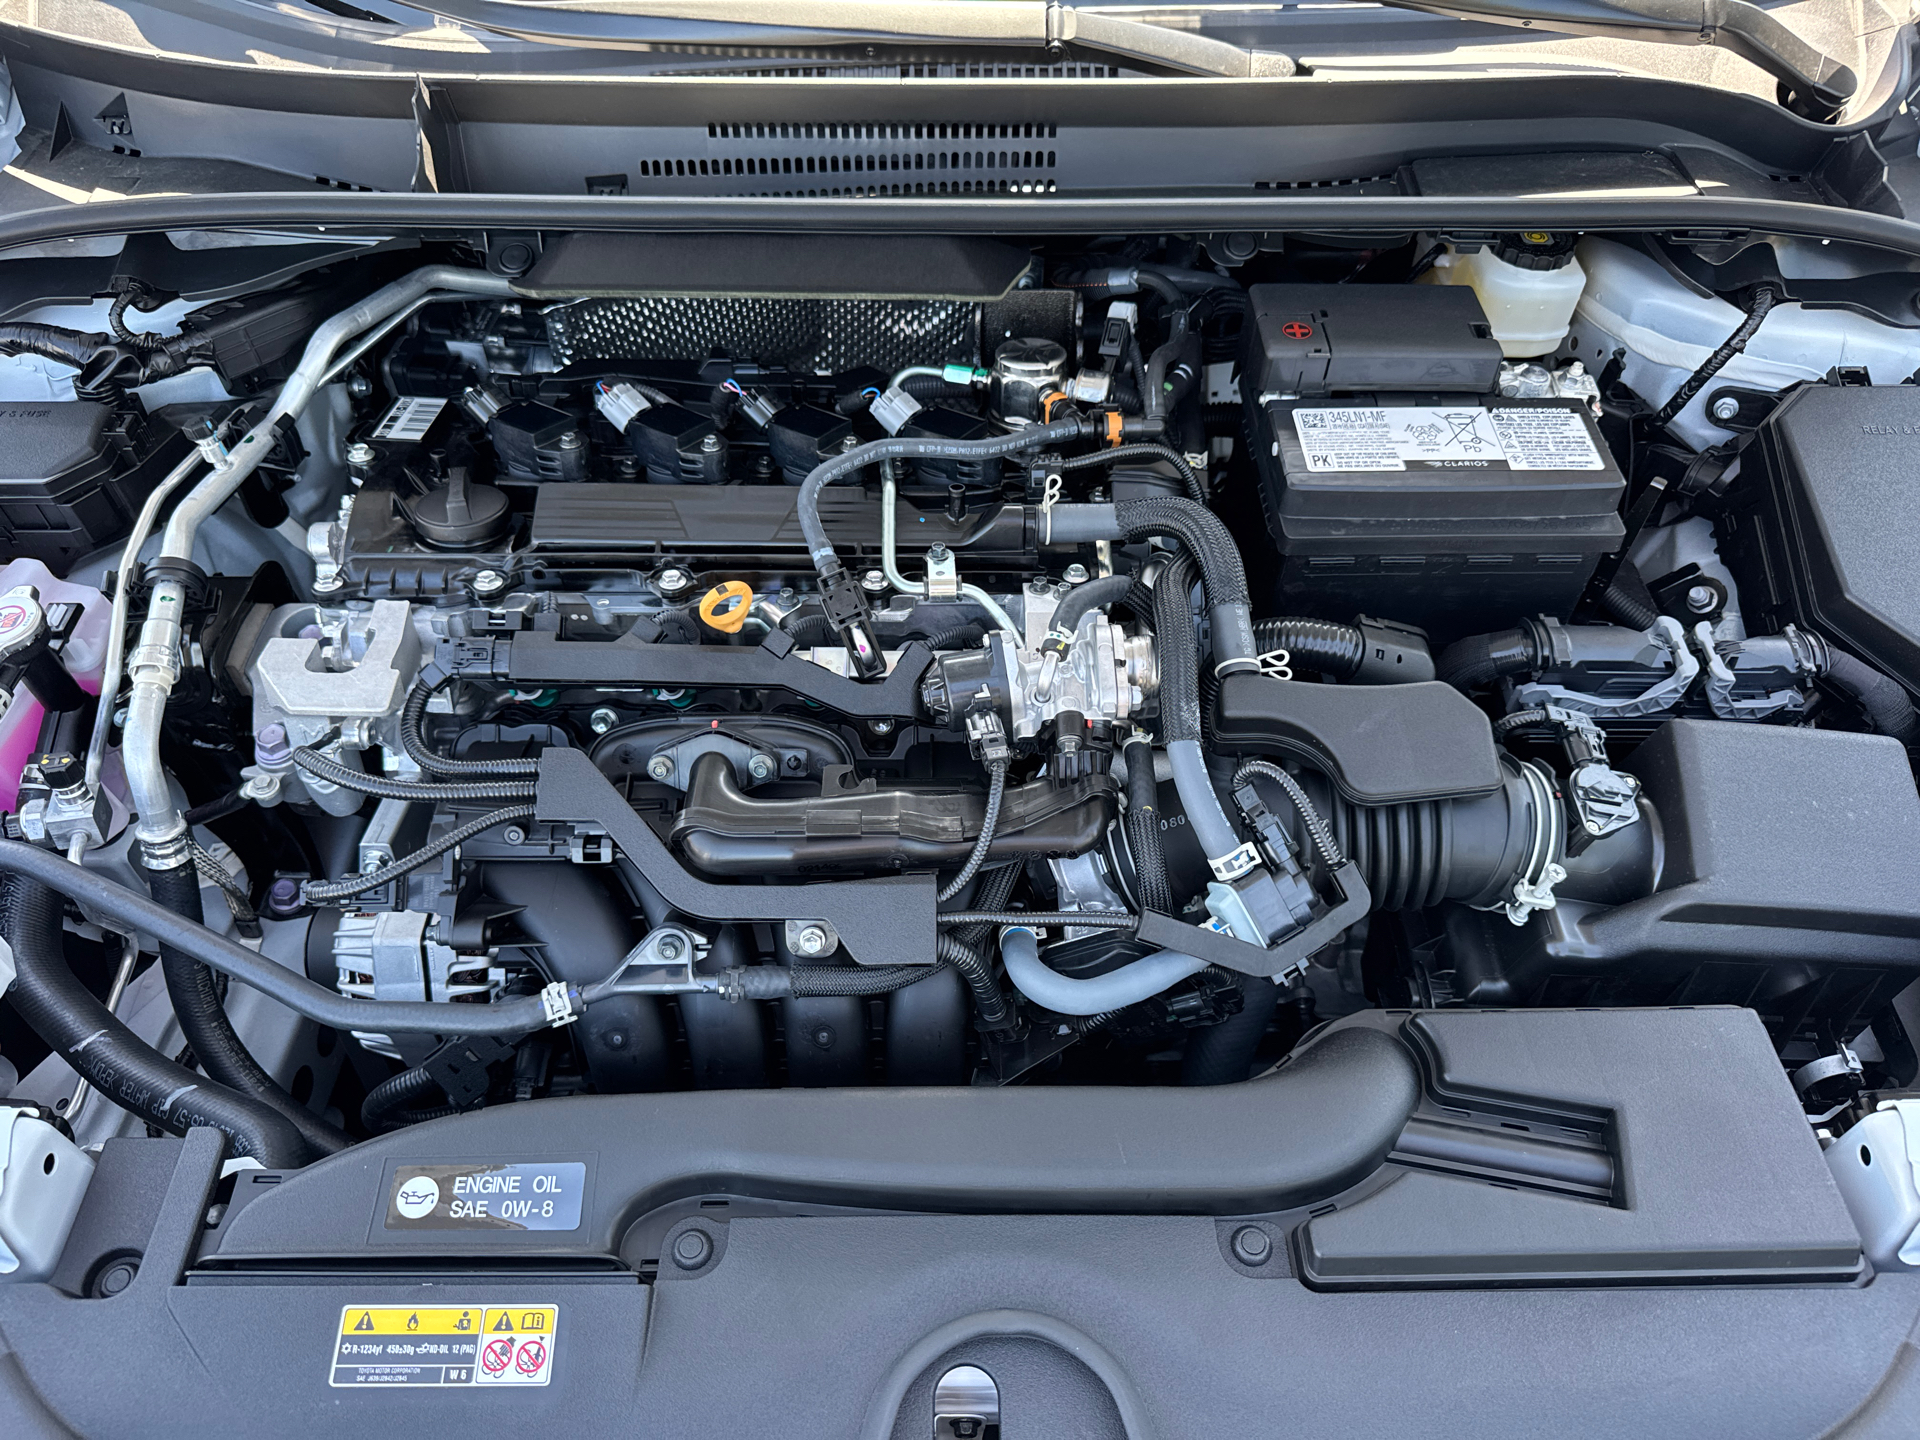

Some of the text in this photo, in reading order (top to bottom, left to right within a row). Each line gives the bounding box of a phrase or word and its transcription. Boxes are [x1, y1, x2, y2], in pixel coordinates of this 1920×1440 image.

[1328, 411, 1386, 423] 345LN1-MF
[1861, 425, 1898, 435] RELAY
[1902, 425, 1911, 435] &
[1463, 444, 1482, 452] Pb
[1311, 454, 1332, 467] PK
[119, 1079, 151, 1110] WATER
[453, 1175, 562, 1194] ENGINE OIL
[449, 1200, 554, 1218] SAE 0W-8
[352, 1344, 476, 1356] R-1234yf 450±30g ND-OIL 12 (PAG)
[449, 1369, 467, 1380] W 6
